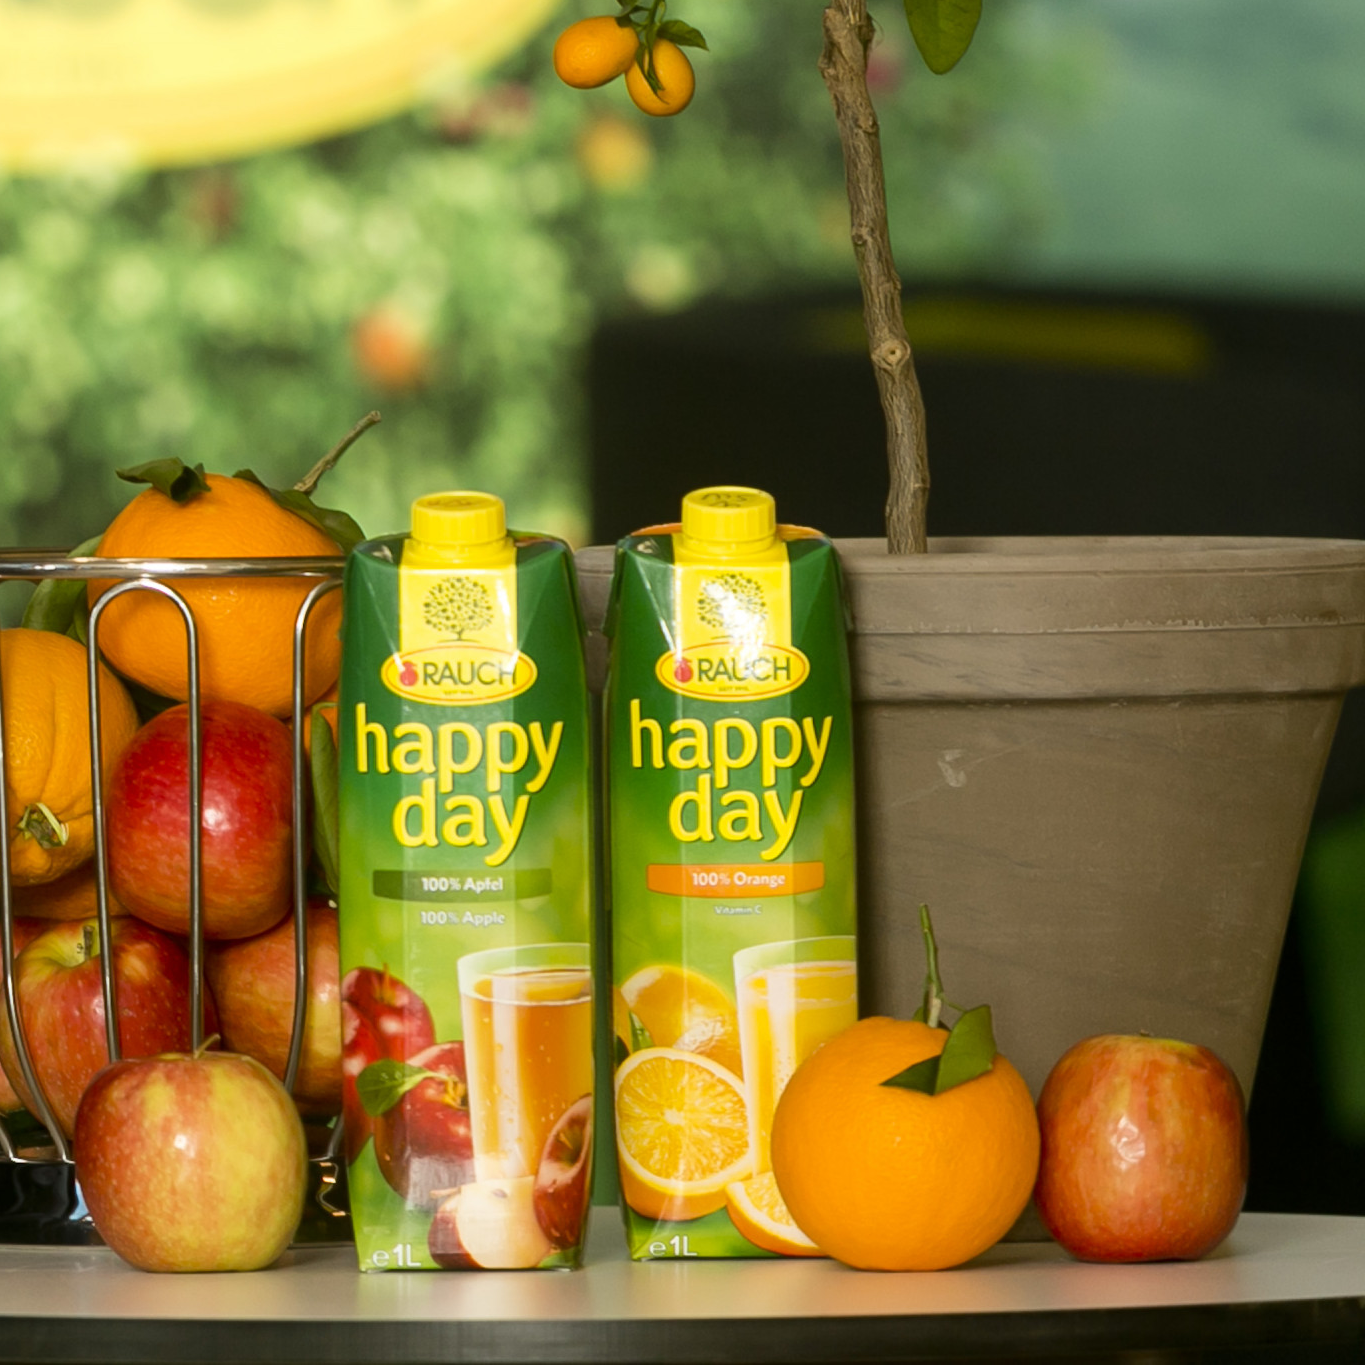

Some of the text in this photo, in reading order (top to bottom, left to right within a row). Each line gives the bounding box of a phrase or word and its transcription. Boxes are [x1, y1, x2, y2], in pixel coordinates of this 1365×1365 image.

[423, 661, 517, 685] RAUCH
[698, 657, 791, 682] RAUCH
[355, 702, 564, 793] happy
[630, 698, 833, 788] happy
[392, 777, 530, 867] day
[669, 773, 804, 861] day
[421, 877, 503, 894] 100% Apfel
[692, 872, 786, 889] 100% Orange
[420, 911, 505, 927] 100% Apple
